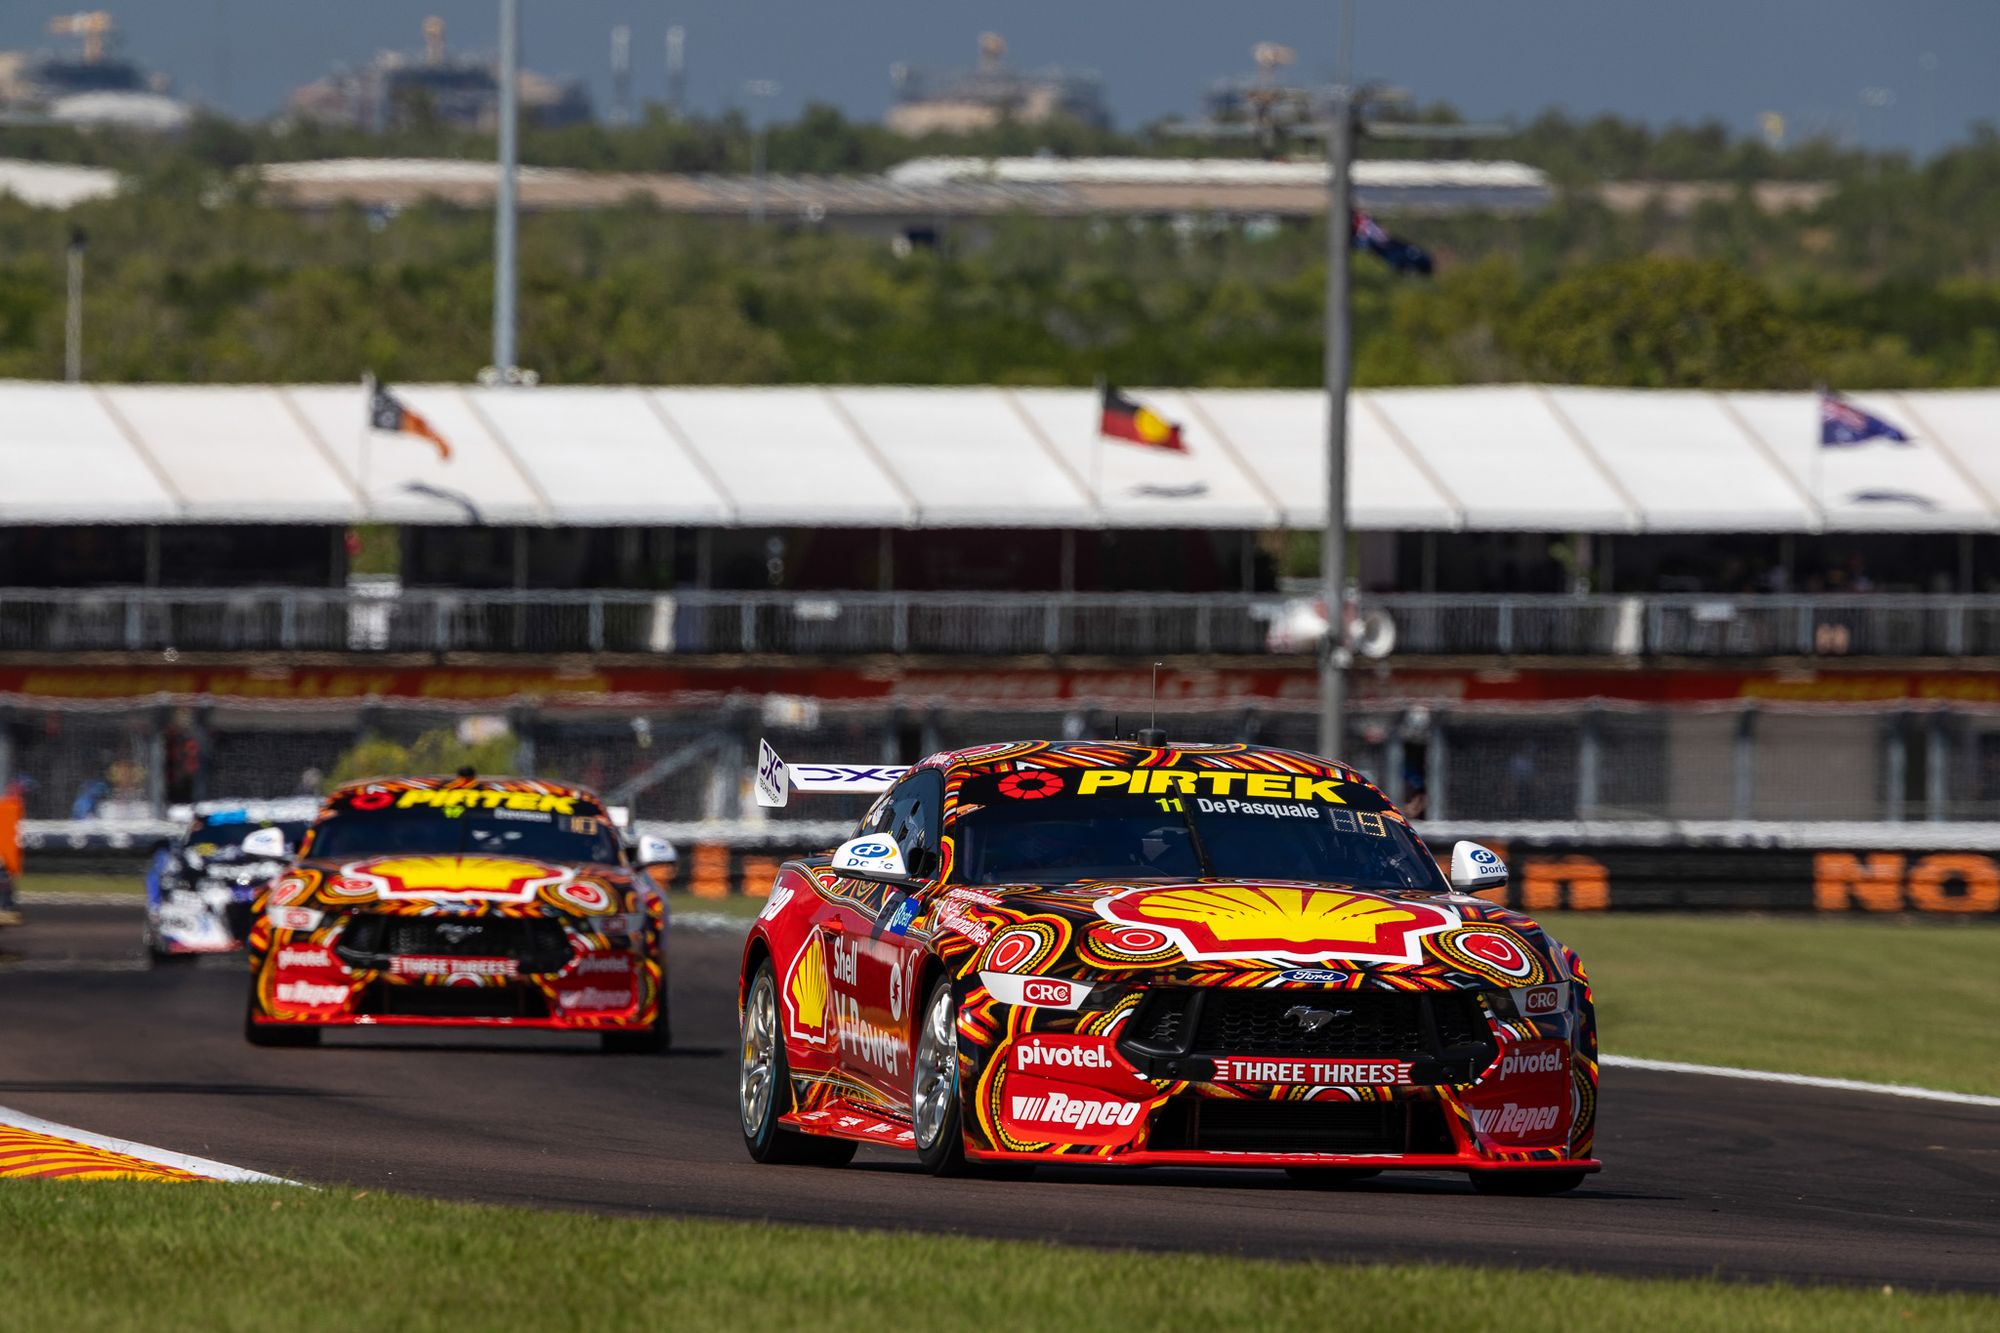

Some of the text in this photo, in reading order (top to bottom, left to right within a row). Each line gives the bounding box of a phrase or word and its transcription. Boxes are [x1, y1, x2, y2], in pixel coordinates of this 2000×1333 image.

[1077, 769, 1347, 805] PIRTEK
[1155, 798, 1184, 813] 11
[1479, 864, 1509, 875] Doric
[833, 935, 858, 986] Shell
[1292, 970, 1335, 981] Ford
[1025, 983, 1070, 1002] CRC
[1527, 990, 1557, 1007] CRC
[834, 989, 899, 1077] V-Power
[1017, 1038, 1112, 1070] pivotel.
[1500, 1048, 1563, 1081] pivotel.
[1232, 1061, 1396, 1084] THREE THREES
[1040, 1091, 1141, 1130] Repco
[1494, 1102, 1560, 1138] Repco
